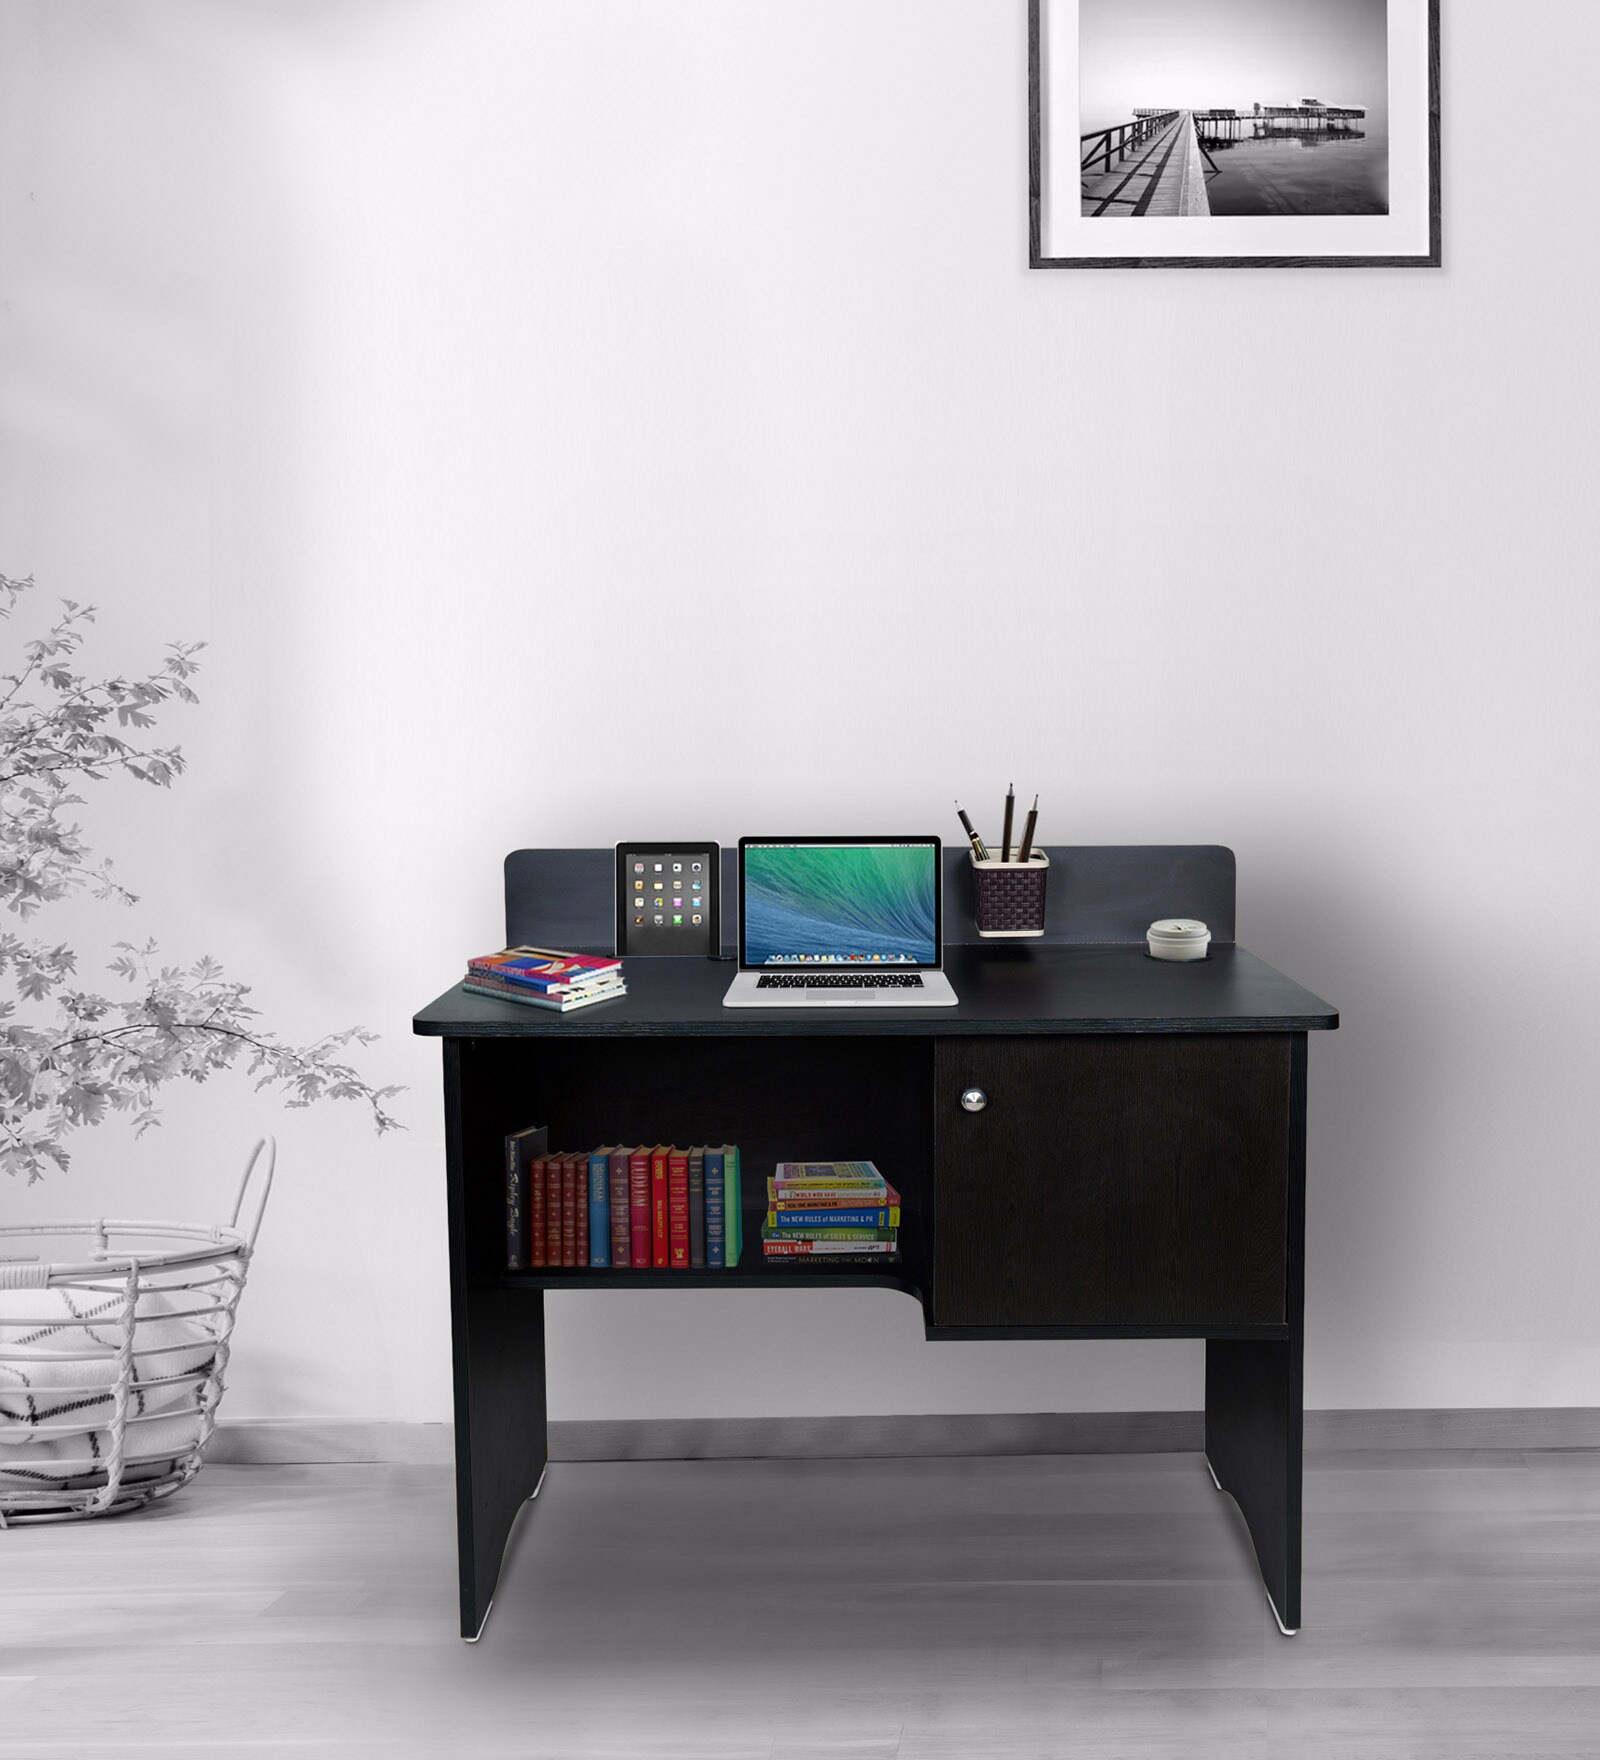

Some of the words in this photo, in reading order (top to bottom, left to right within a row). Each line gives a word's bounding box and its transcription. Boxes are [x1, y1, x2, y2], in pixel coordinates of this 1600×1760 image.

[631, 1161, 649, 1207] LUDLUM
[780, 1215, 790, 1223] The
[791, 1215, 803, 1223] NEW
[804, 1215, 821, 1223] RULES
[822, 1215, 828, 1223] of
[829, 1215, 859, 1223] MARKETING
[860, 1215, 864, 1223] &
[865, 1215, 874, 1223] PR
[782, 1231, 791, 1239] The
[792, 1231, 804, 1239] NEW
[805, 1232, 822, 1240] RULES
[823, 1232, 829, 1240] of
[829, 1232, 846, 1240] SALES
[852, 1233, 875, 1241] SERVICE
[798, 1256, 840, 1264] MARKETING
